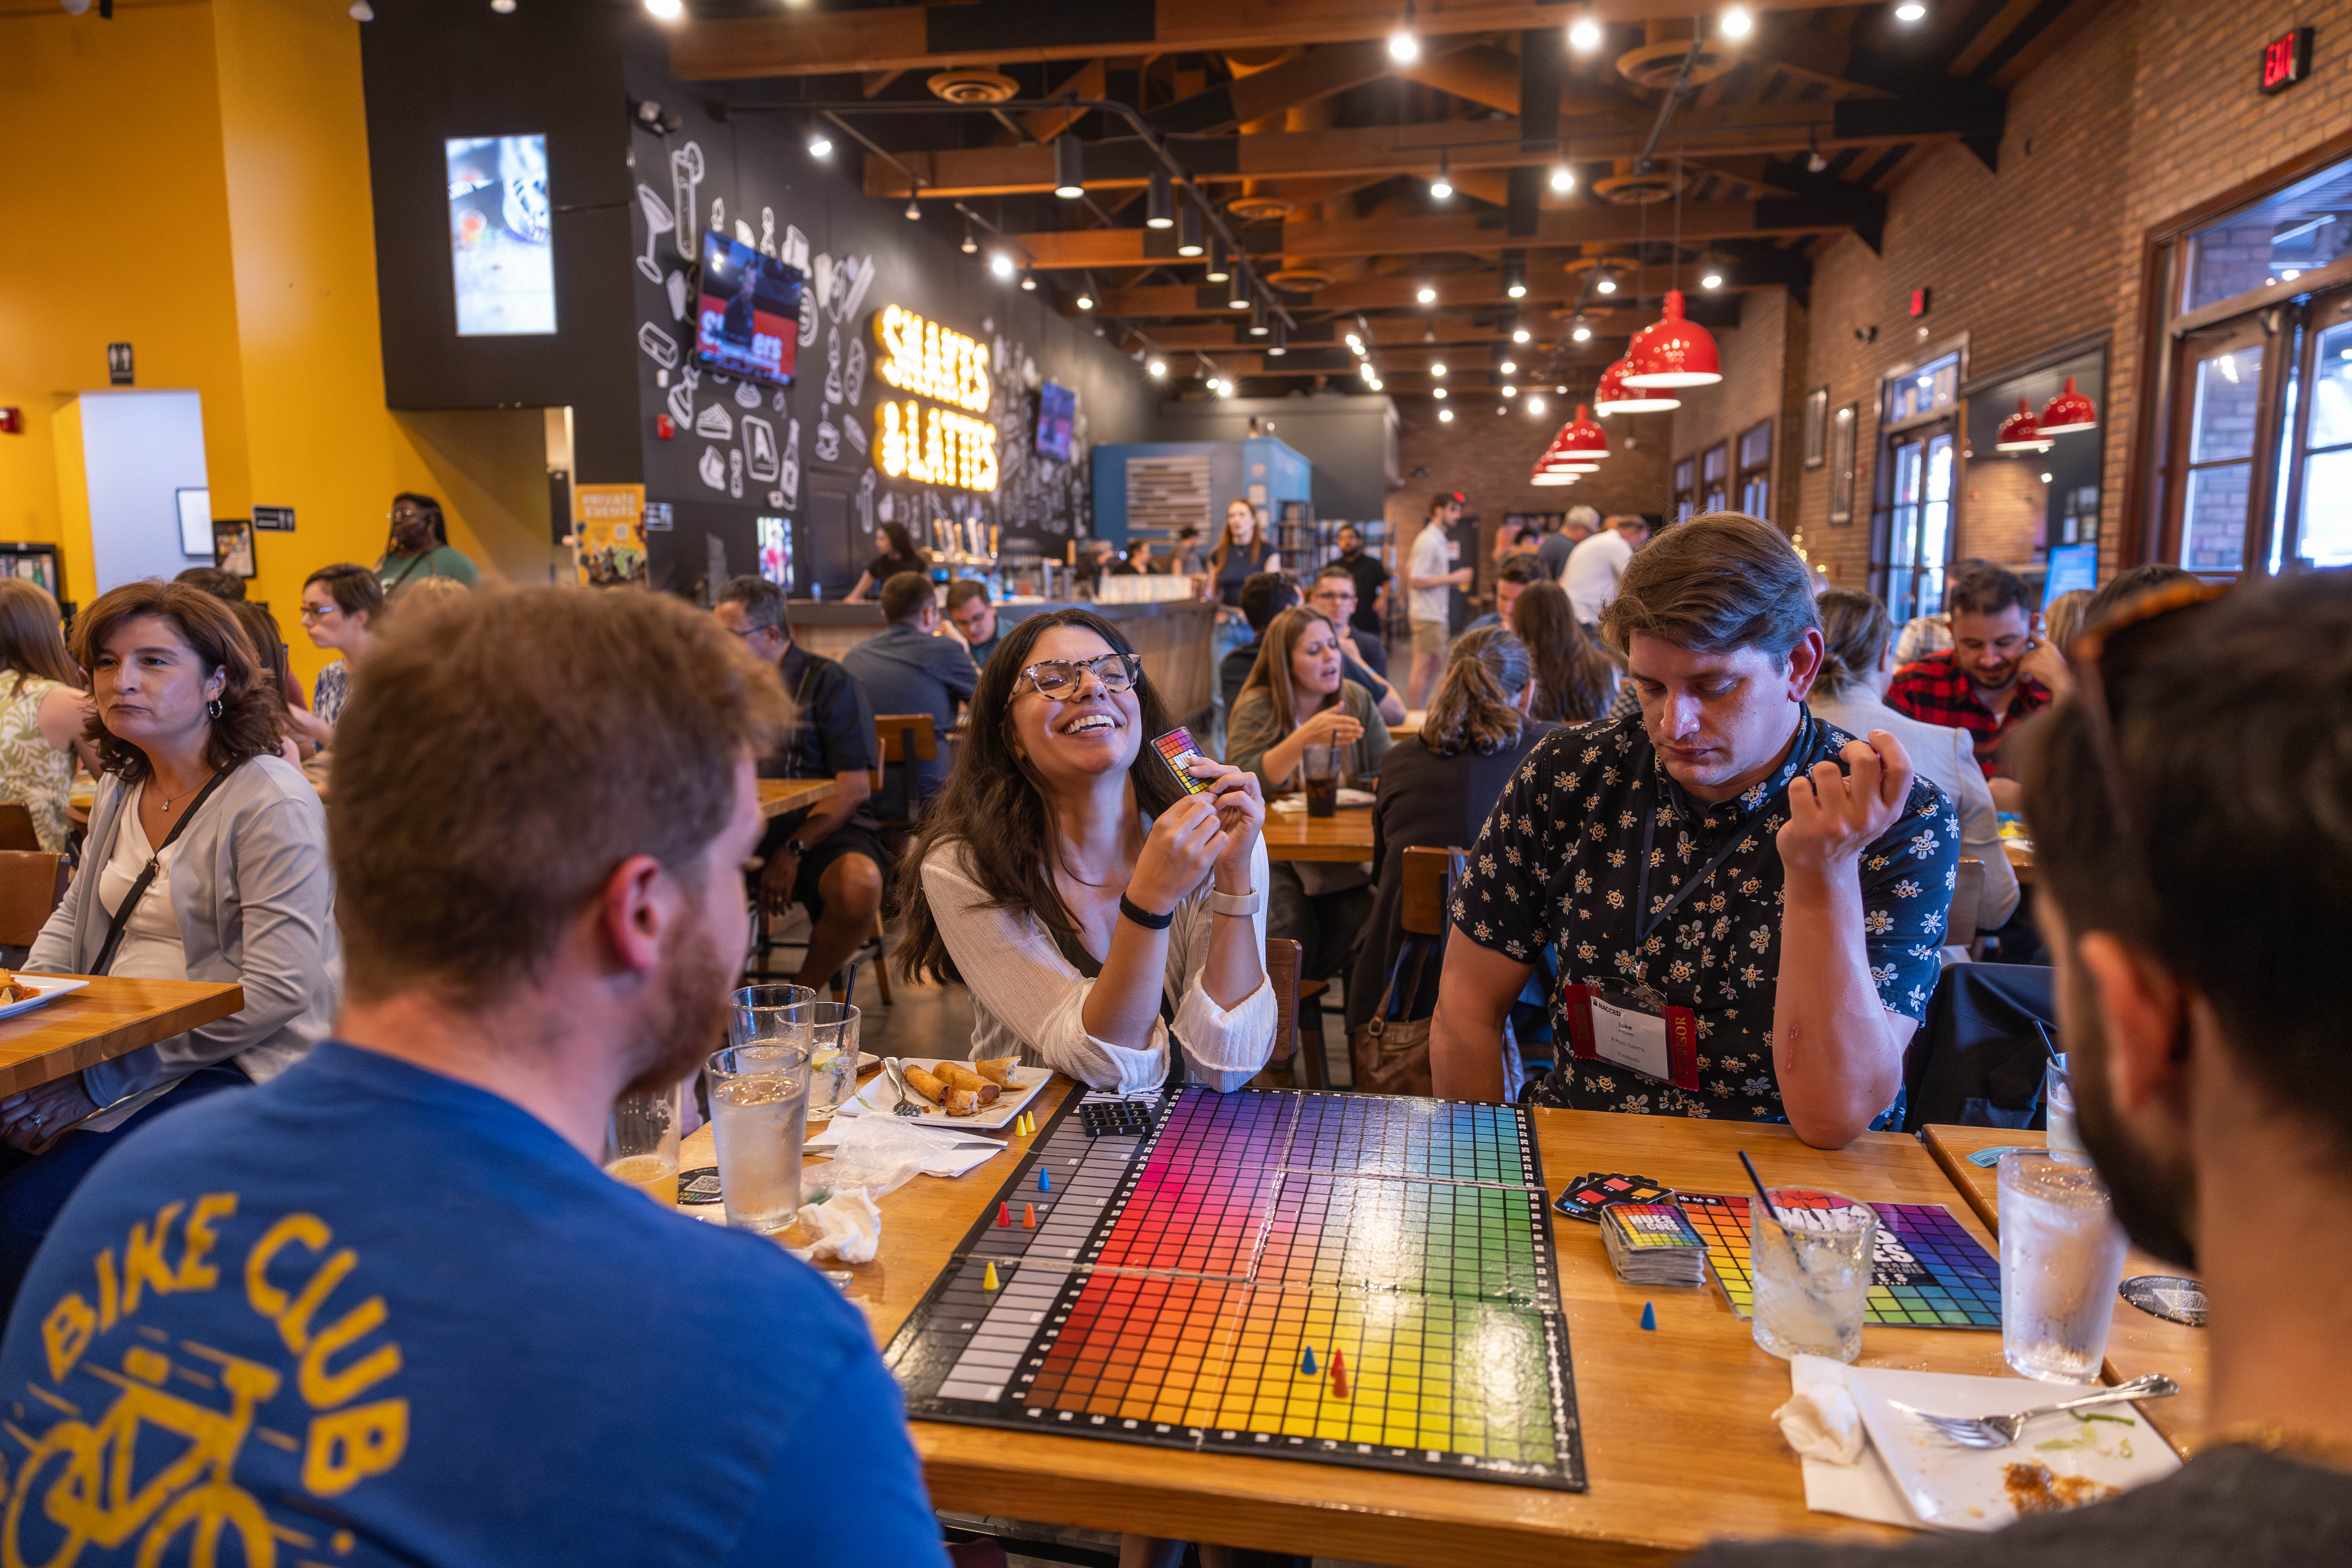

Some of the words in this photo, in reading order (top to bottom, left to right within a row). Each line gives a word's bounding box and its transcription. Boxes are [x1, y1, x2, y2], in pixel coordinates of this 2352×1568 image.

[581, 493, 637, 505] PRIVATE
[584, 506, 635, 518] EVENTS
[1599, 1002, 1621, 1016] NACCED
[1619, 1022, 1632, 1030] Luke
[1627, 1043, 1645, 1052] County
[1618, 1052, 1640, 1063] Colorado
[1628, 1215, 1676, 1224] HUES
[42, 1192, 238, 1385] BIKE
[244, 1213, 410, 1497] CLUB
